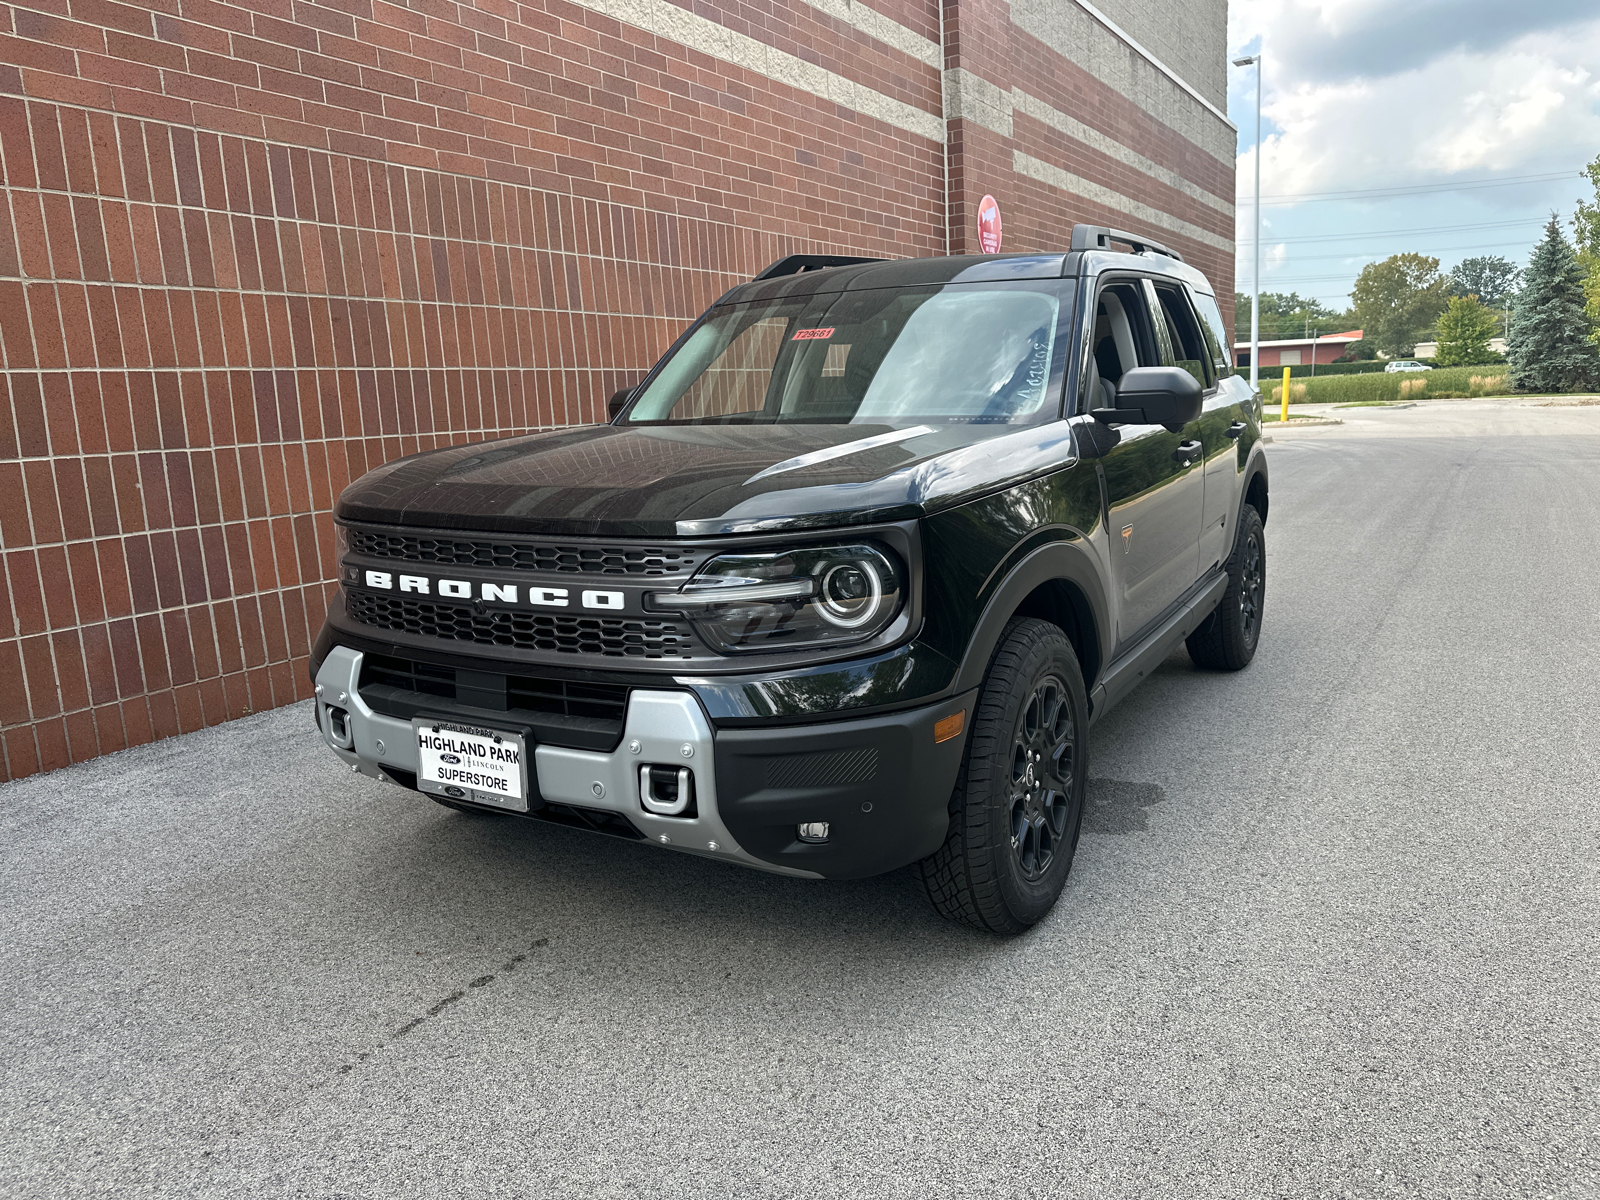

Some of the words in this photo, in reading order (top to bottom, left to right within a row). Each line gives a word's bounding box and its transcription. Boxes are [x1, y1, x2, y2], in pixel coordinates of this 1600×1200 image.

[796, 329, 831, 339] T29661
[365, 570, 625, 610] BRONCO
[437, 722, 474, 735] HIGHLAND
[475, 728, 495, 739] PARK
[419, 735, 487, 758] HIGHLAND
[489, 746, 520, 765] PARK
[442, 754, 459, 764] Ford
[472, 760, 505, 772] LINCOLN
[437, 767, 508, 791] SUPERSTORE
